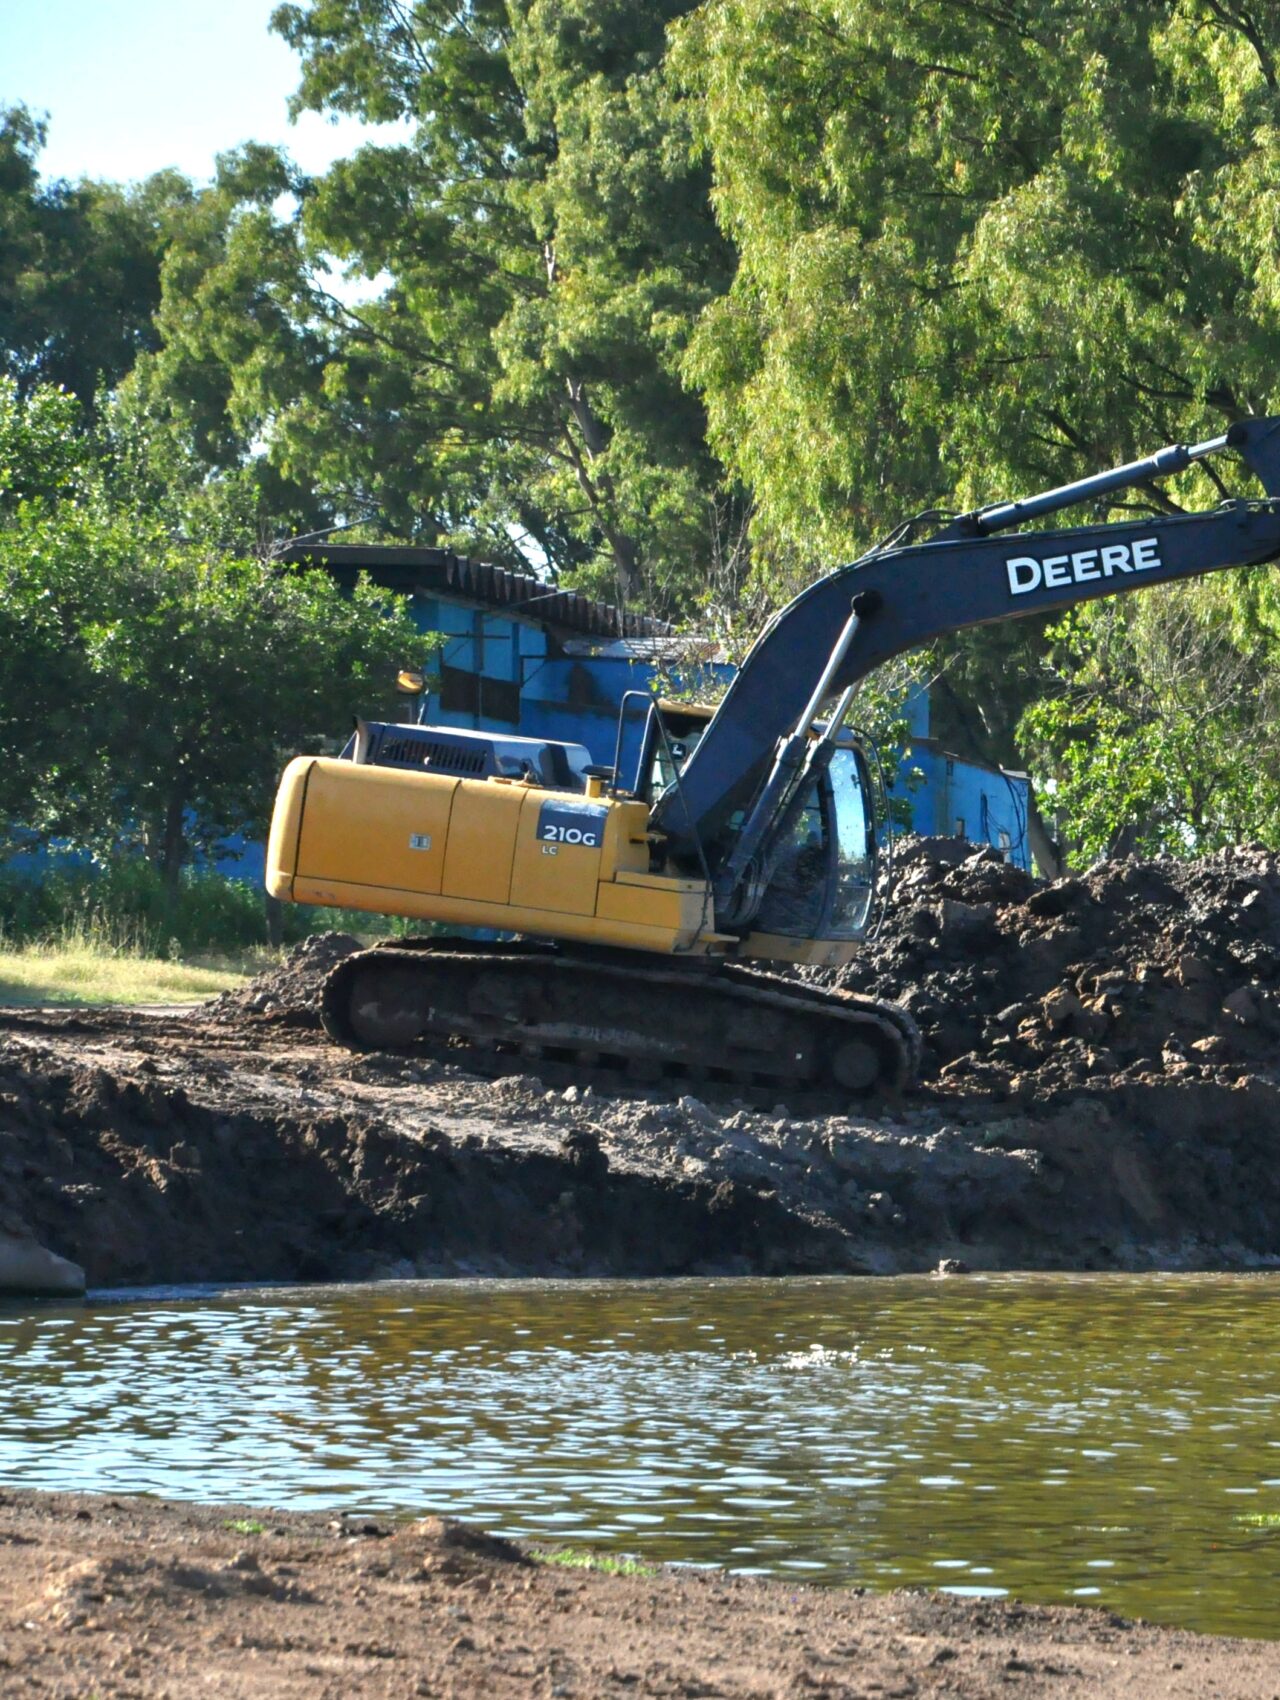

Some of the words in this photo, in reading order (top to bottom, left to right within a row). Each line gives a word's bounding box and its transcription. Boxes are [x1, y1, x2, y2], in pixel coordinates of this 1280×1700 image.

[1006, 538, 1161, 595] DEERE
[543, 825, 596, 846] 210G
[542, 846, 557, 855] LC
